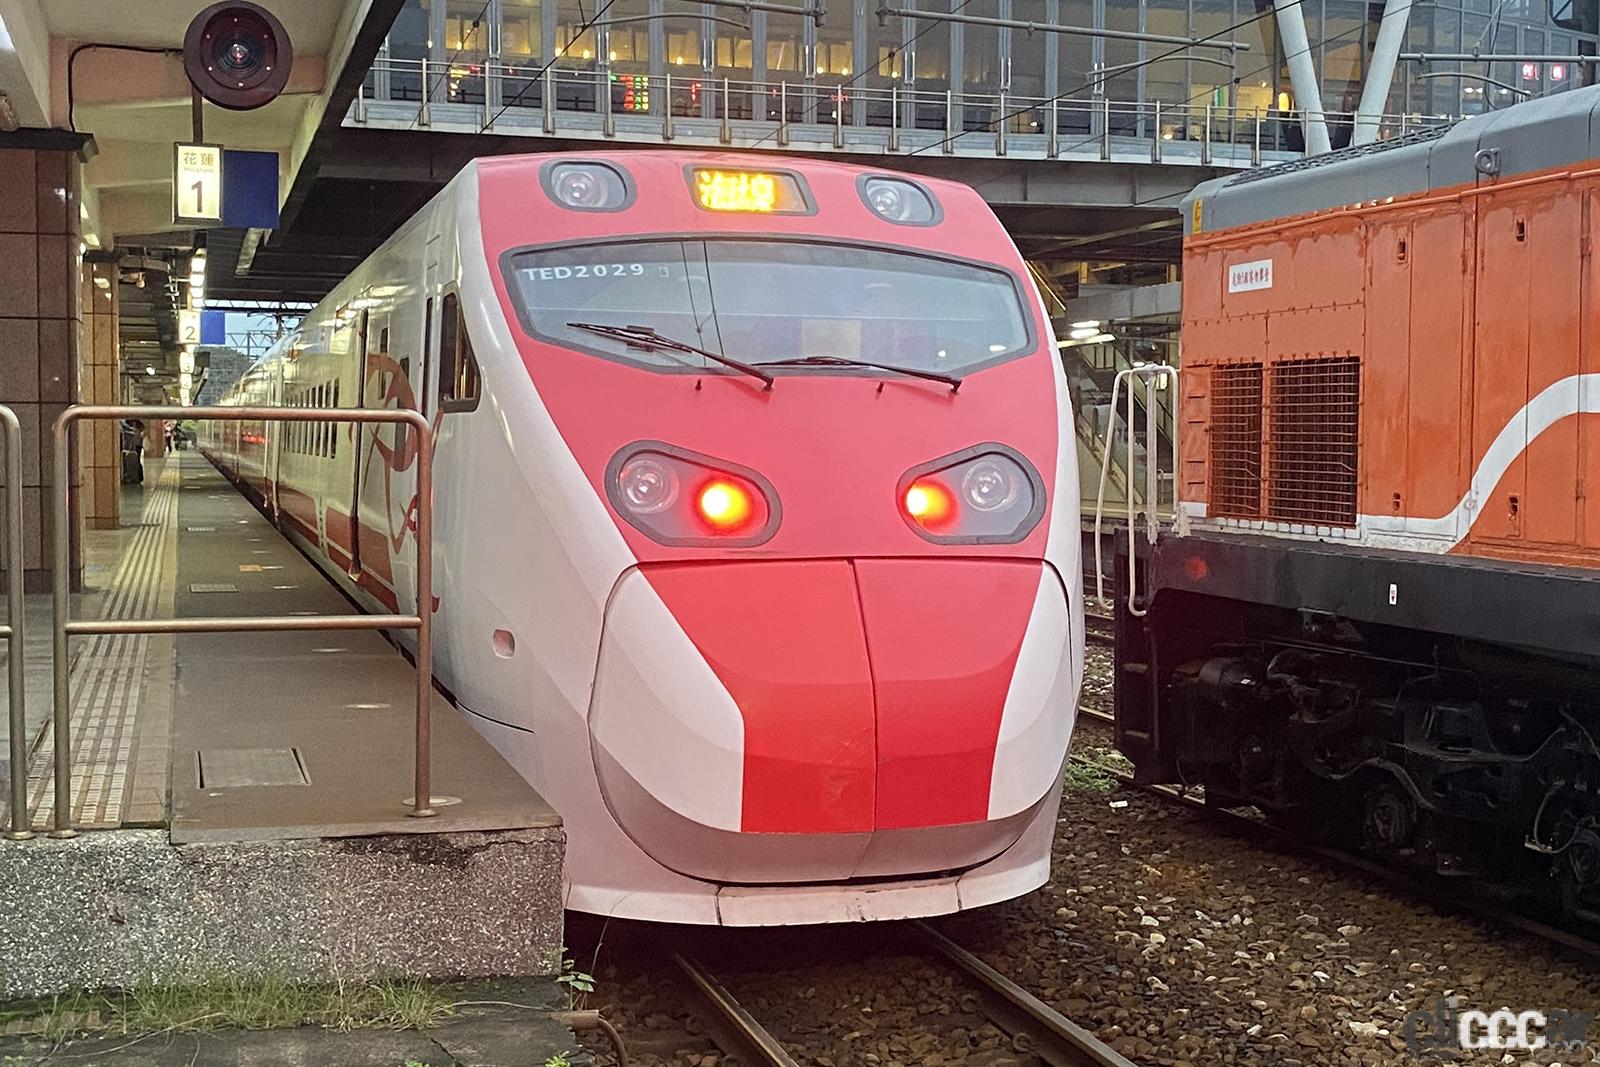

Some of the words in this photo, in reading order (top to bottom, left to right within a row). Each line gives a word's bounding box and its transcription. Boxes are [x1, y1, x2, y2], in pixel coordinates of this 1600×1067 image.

[191, 180, 203, 213] 1
[522, 263, 645, 281] TED2029
[185, 326, 196, 340] 2
